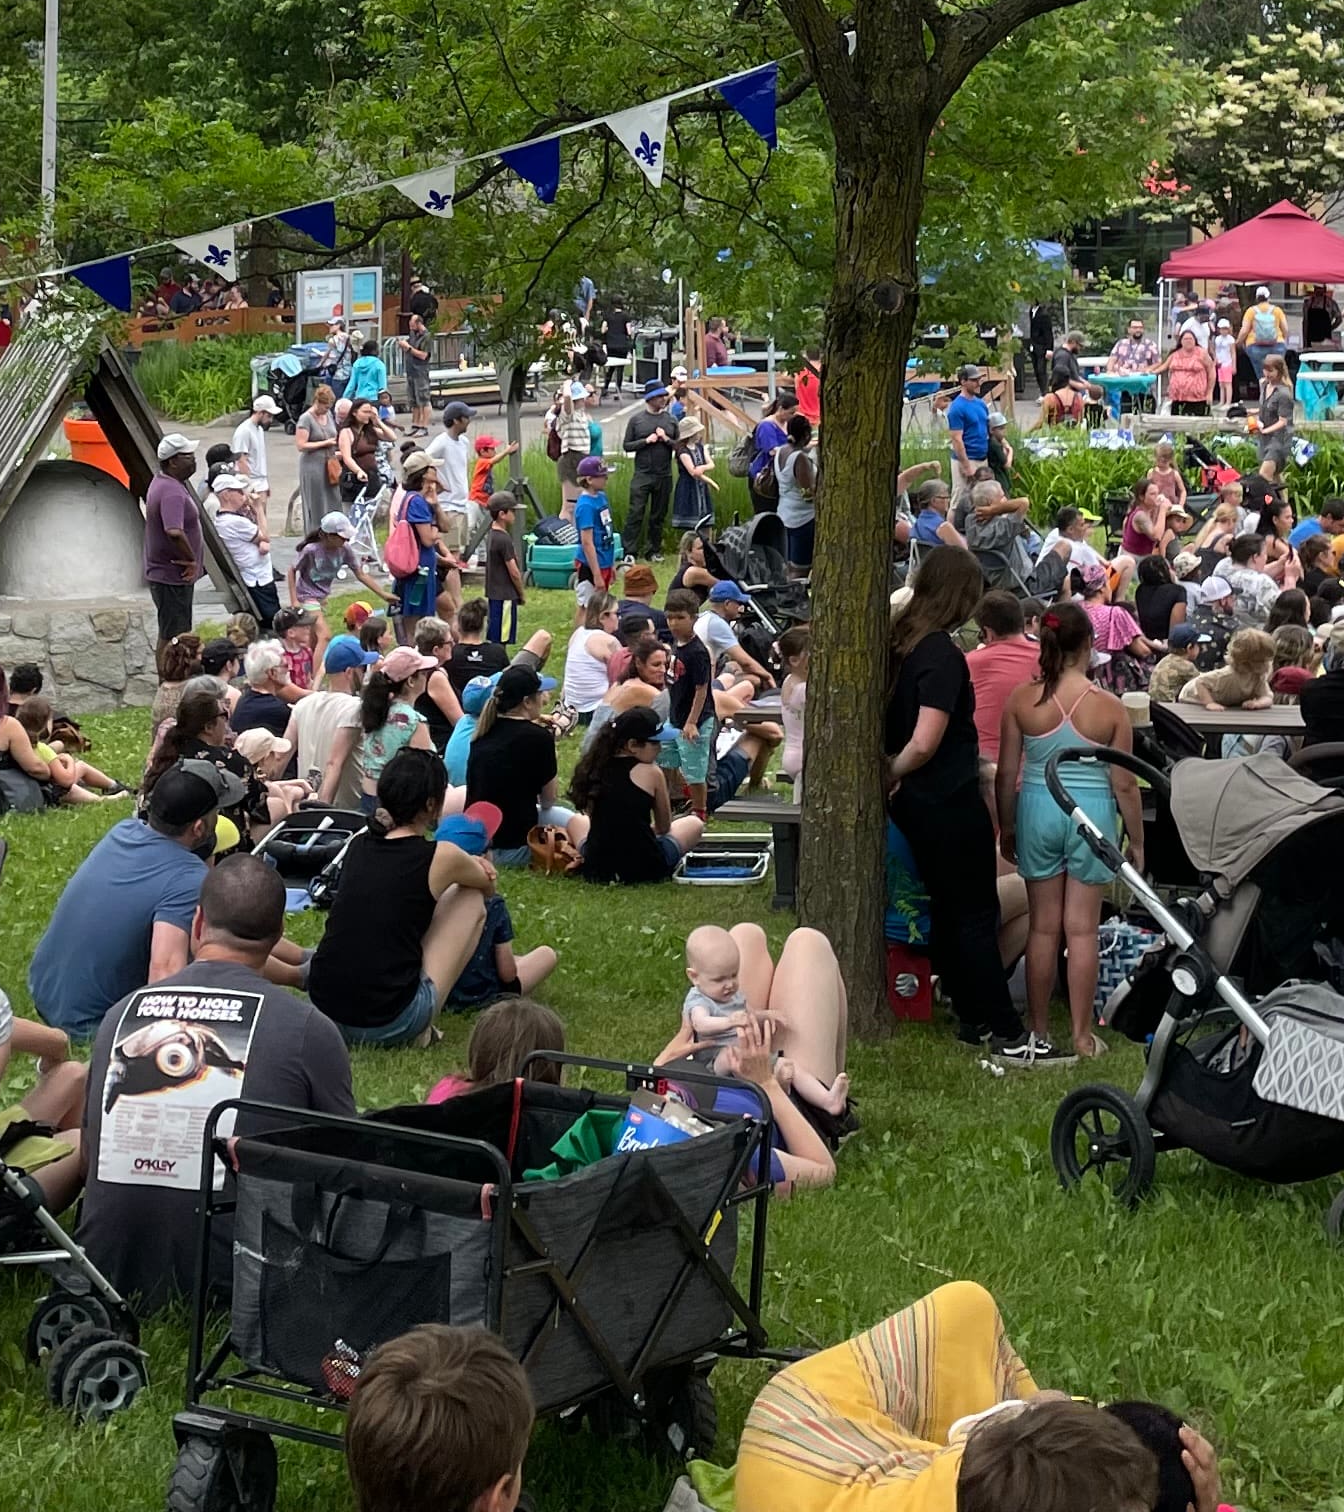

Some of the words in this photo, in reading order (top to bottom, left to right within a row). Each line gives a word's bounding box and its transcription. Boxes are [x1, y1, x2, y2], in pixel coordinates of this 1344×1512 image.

[140, 995, 177, 1007] HOW
[176, 996, 198, 1008] TO
[198, 997, 242, 1009] HOLD
[136, 1006, 175, 1017] YOUR
[175, 1007, 243, 1021] HORSES.
[134, 1158, 176, 1172] OAKLEY
